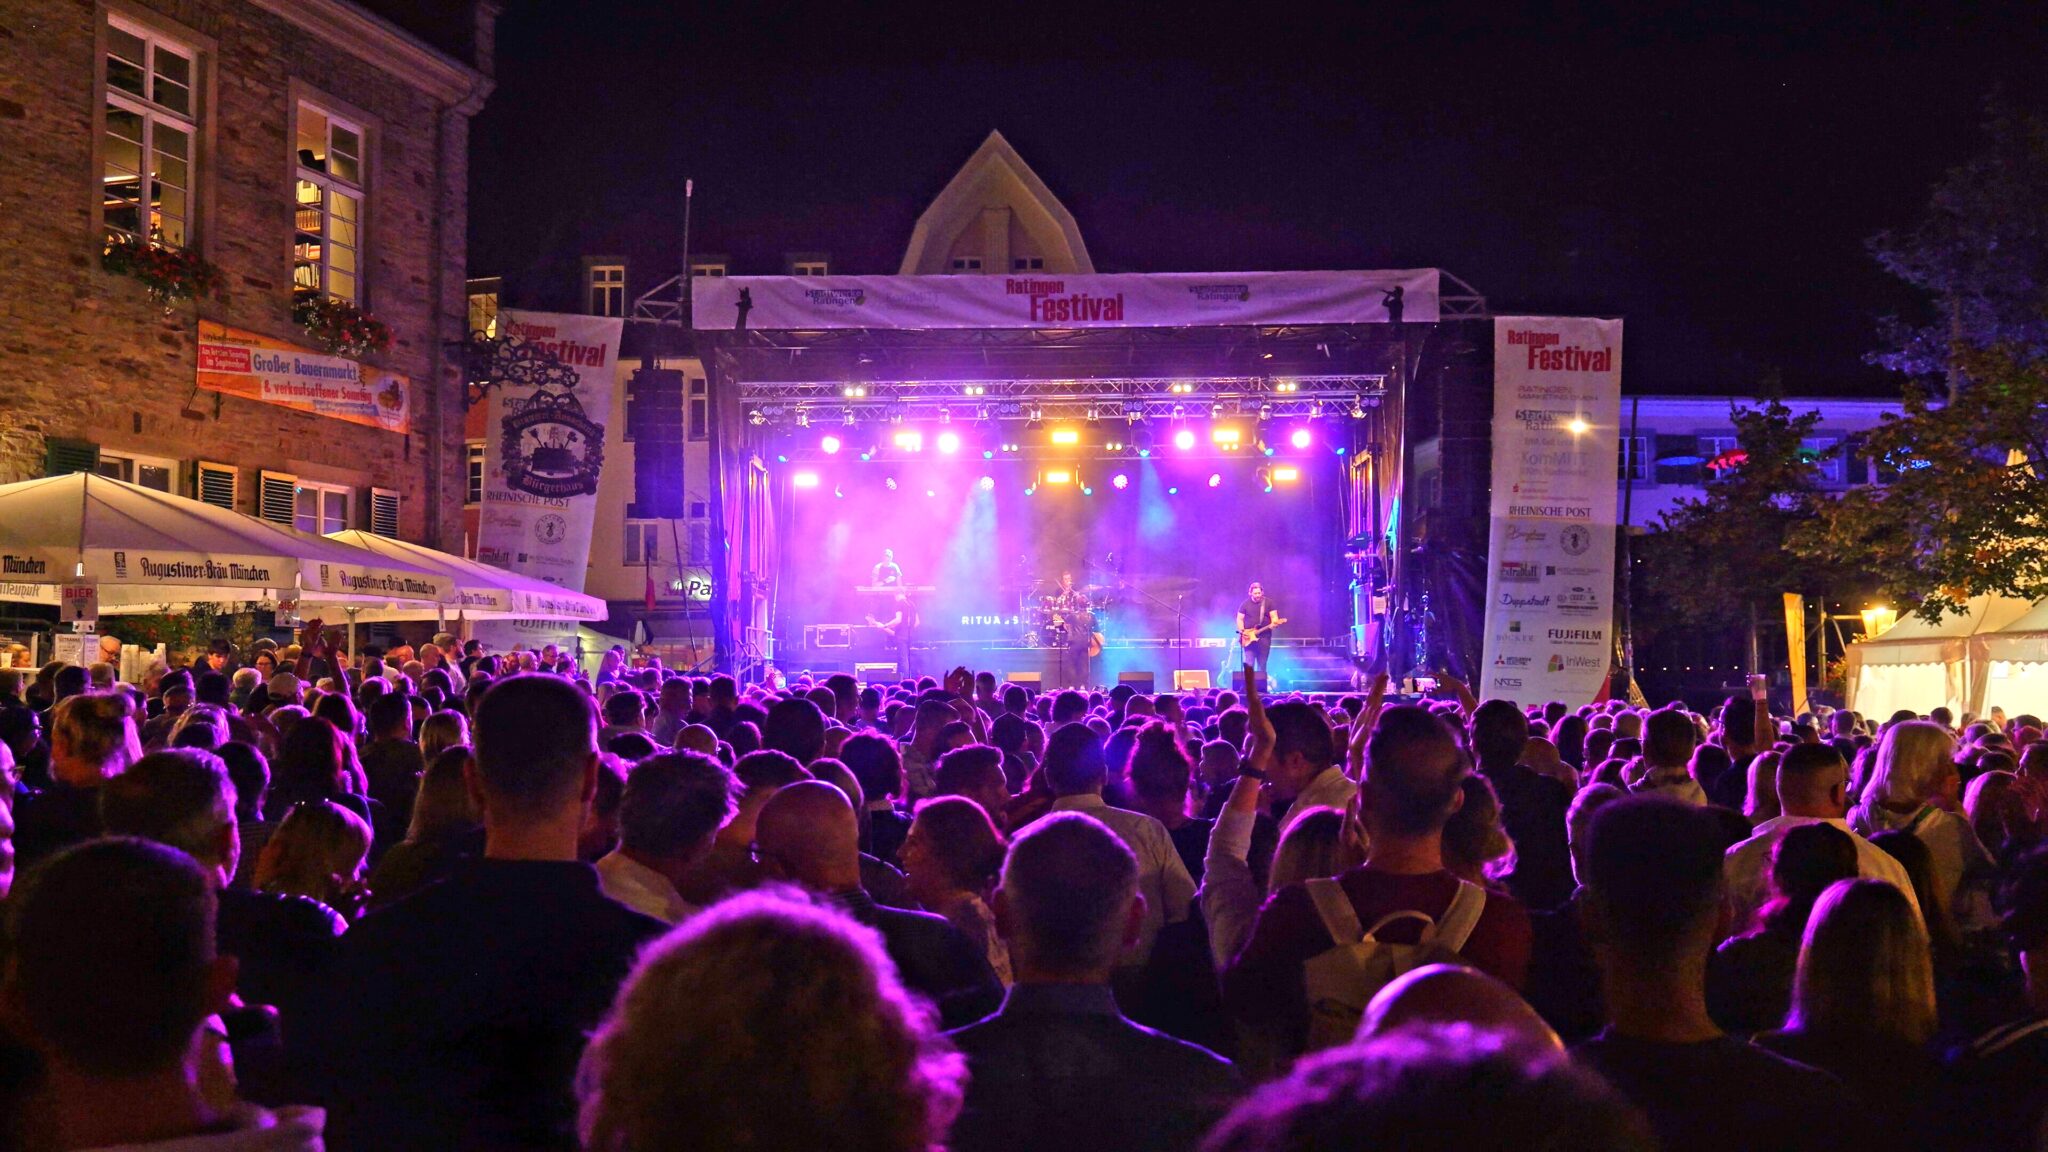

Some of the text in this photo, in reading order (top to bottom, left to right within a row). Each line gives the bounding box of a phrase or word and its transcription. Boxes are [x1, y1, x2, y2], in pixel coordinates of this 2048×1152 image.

[1006, 279, 1065, 297] Ratingen
[1030, 293, 1123, 321] Festival
[504, 321, 556, 340] Ratingen
[1507, 330, 1559, 348] Ratingen
[253, 353, 358, 381] Großer Bauernmarkt
[1528, 346, 1612, 371] Festival
[264, 380, 373, 404] & verkaufsoffener Sonntag
[486, 491, 570, 508] RHEINISCHE POST
[1508, 505, 1592, 517] RHEINISCHE POST
[3, 555, 46, 575] München
[229, 563, 270, 581] München
[65, 587, 94, 599] BIER
[405, 578, 437, 595] München
[513, 619, 569, 632] FUJIFILM
[1548, 628, 1602, 640] FUJIFILM
[1566, 656, 1601, 668] InWest
